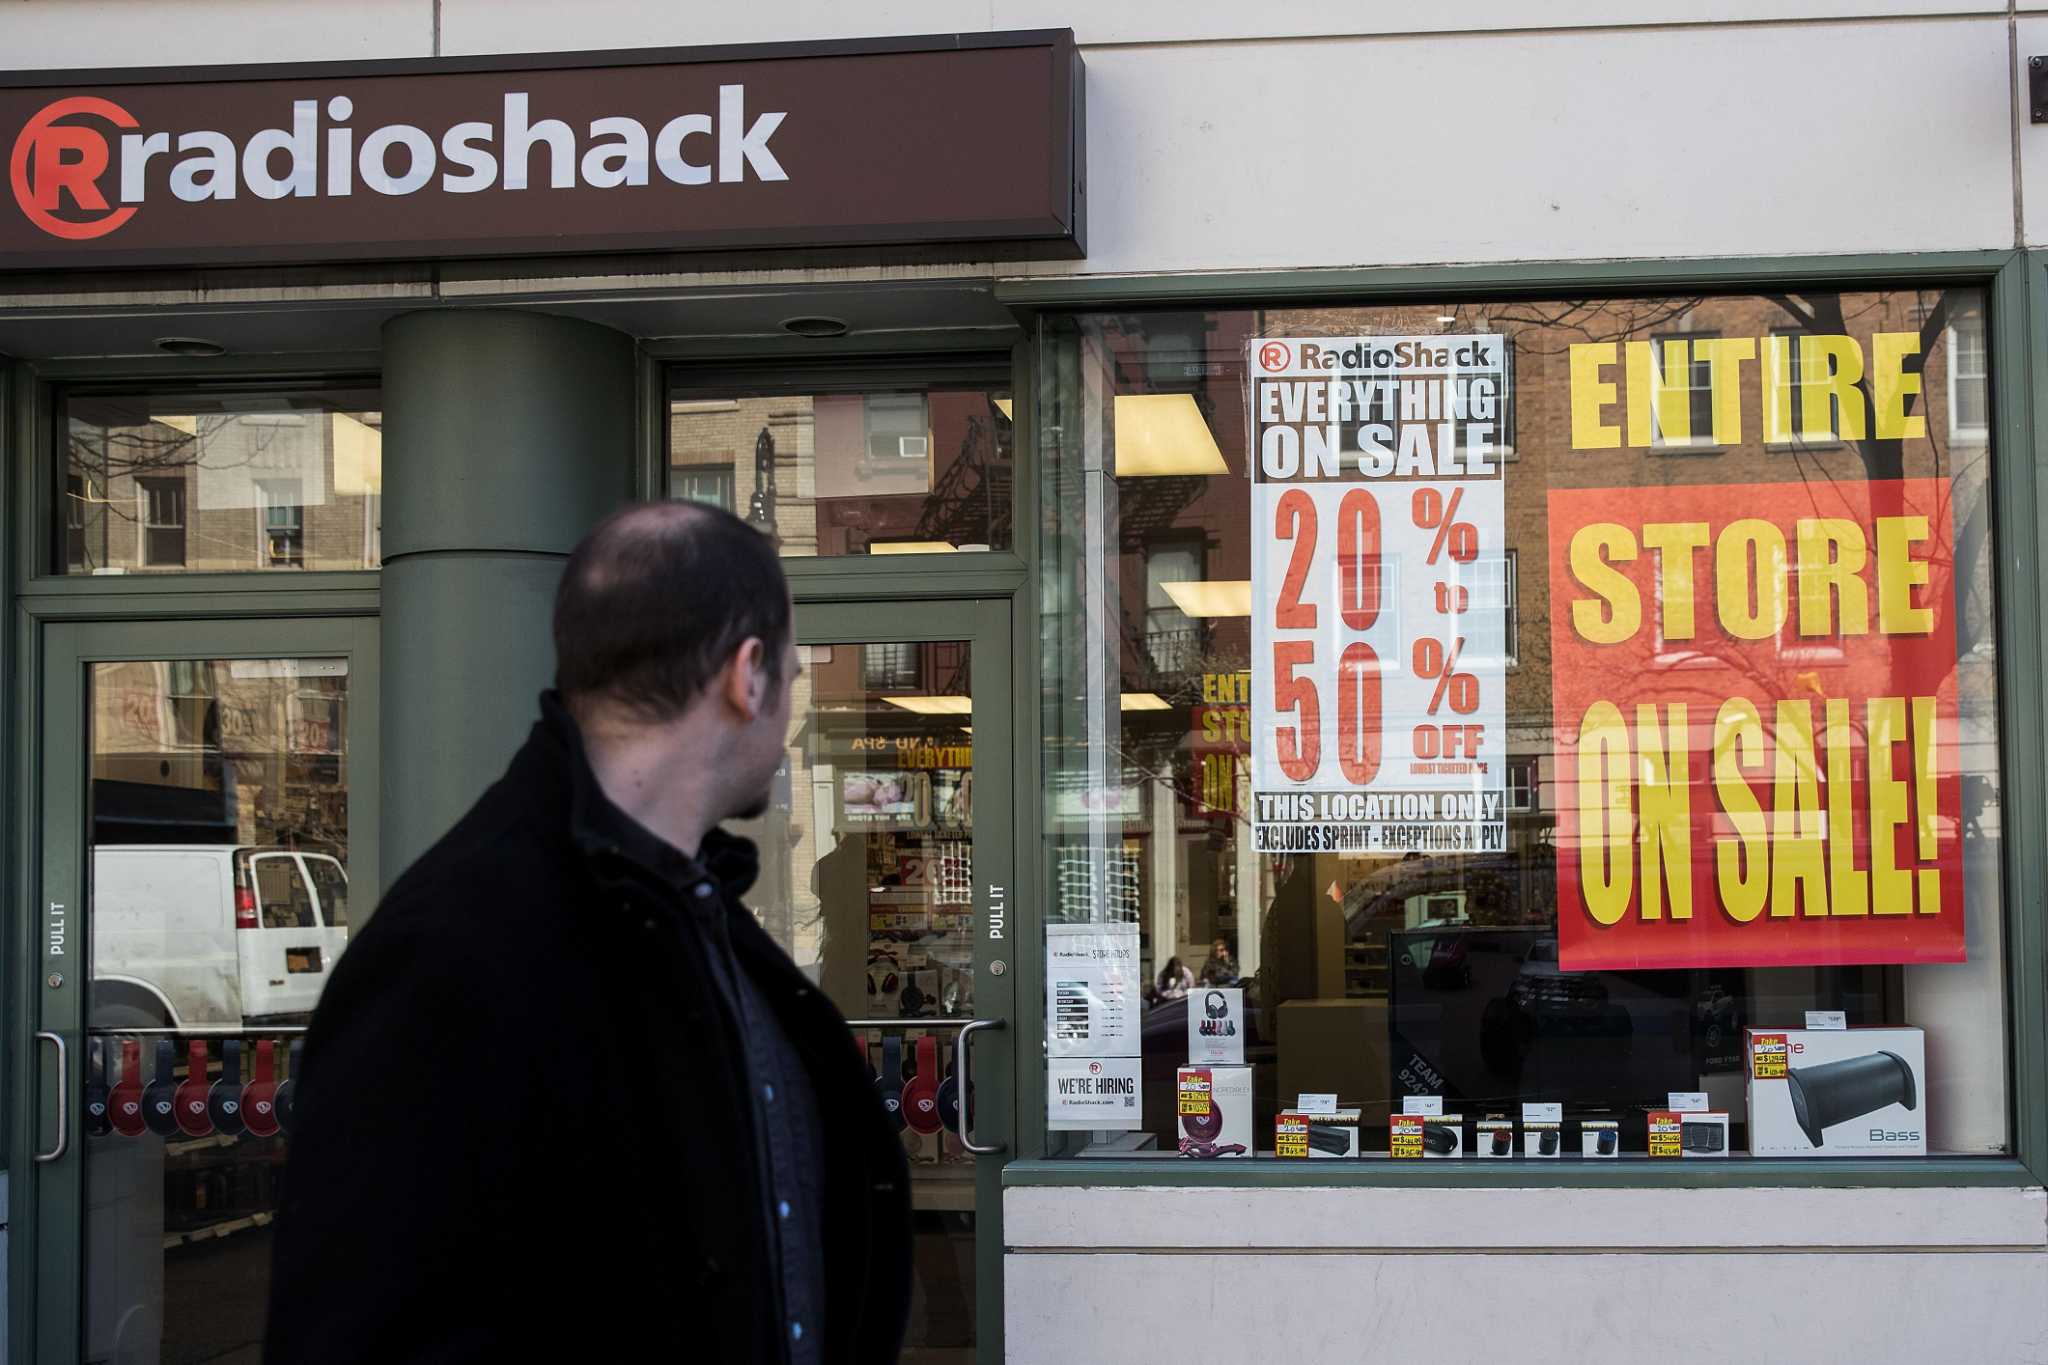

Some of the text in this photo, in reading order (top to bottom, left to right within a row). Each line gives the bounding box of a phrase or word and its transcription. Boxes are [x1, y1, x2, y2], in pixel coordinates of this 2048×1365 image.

[120, 84, 789, 203] radioshack
[1300, 341, 1491, 369] RadioShack
[1261, 378, 1496, 422] EVERYTHING
[1569, 332, 1926, 449] ENTIRE
[1262, 422, 1496, 478] ON SALE
[1434, 581, 1469, 614] to
[1570, 515, 1934, 645] STORE
[1203, 672, 1251, 703] ENT
[898, 746, 972, 768] EVERYTHI
[1412, 724, 1485, 760] OFF
[1203, 753, 1233, 812] ON
[1469, 763, 1488, 774] PCE
[1258, 794, 1499, 821] THIS LOCATION ONLY
[1577, 696, 1942, 925] ON SALE!
[1256, 825, 1320, 850] EXCLUDES
[1323, 825, 1371, 850] SPRINT
[1382, 825, 1462, 850] EXCEPTIONS
[1465, 824, 1504, 850] APLY
[51, 902, 64, 955] PULL IT
[990, 885, 1003, 938] PULL IT
[1058, 1077, 1134, 1095] WE'RE HIRING
[1408, 1054, 1446, 1089] TEAM
[1870, 1128, 1920, 1141] Bass
